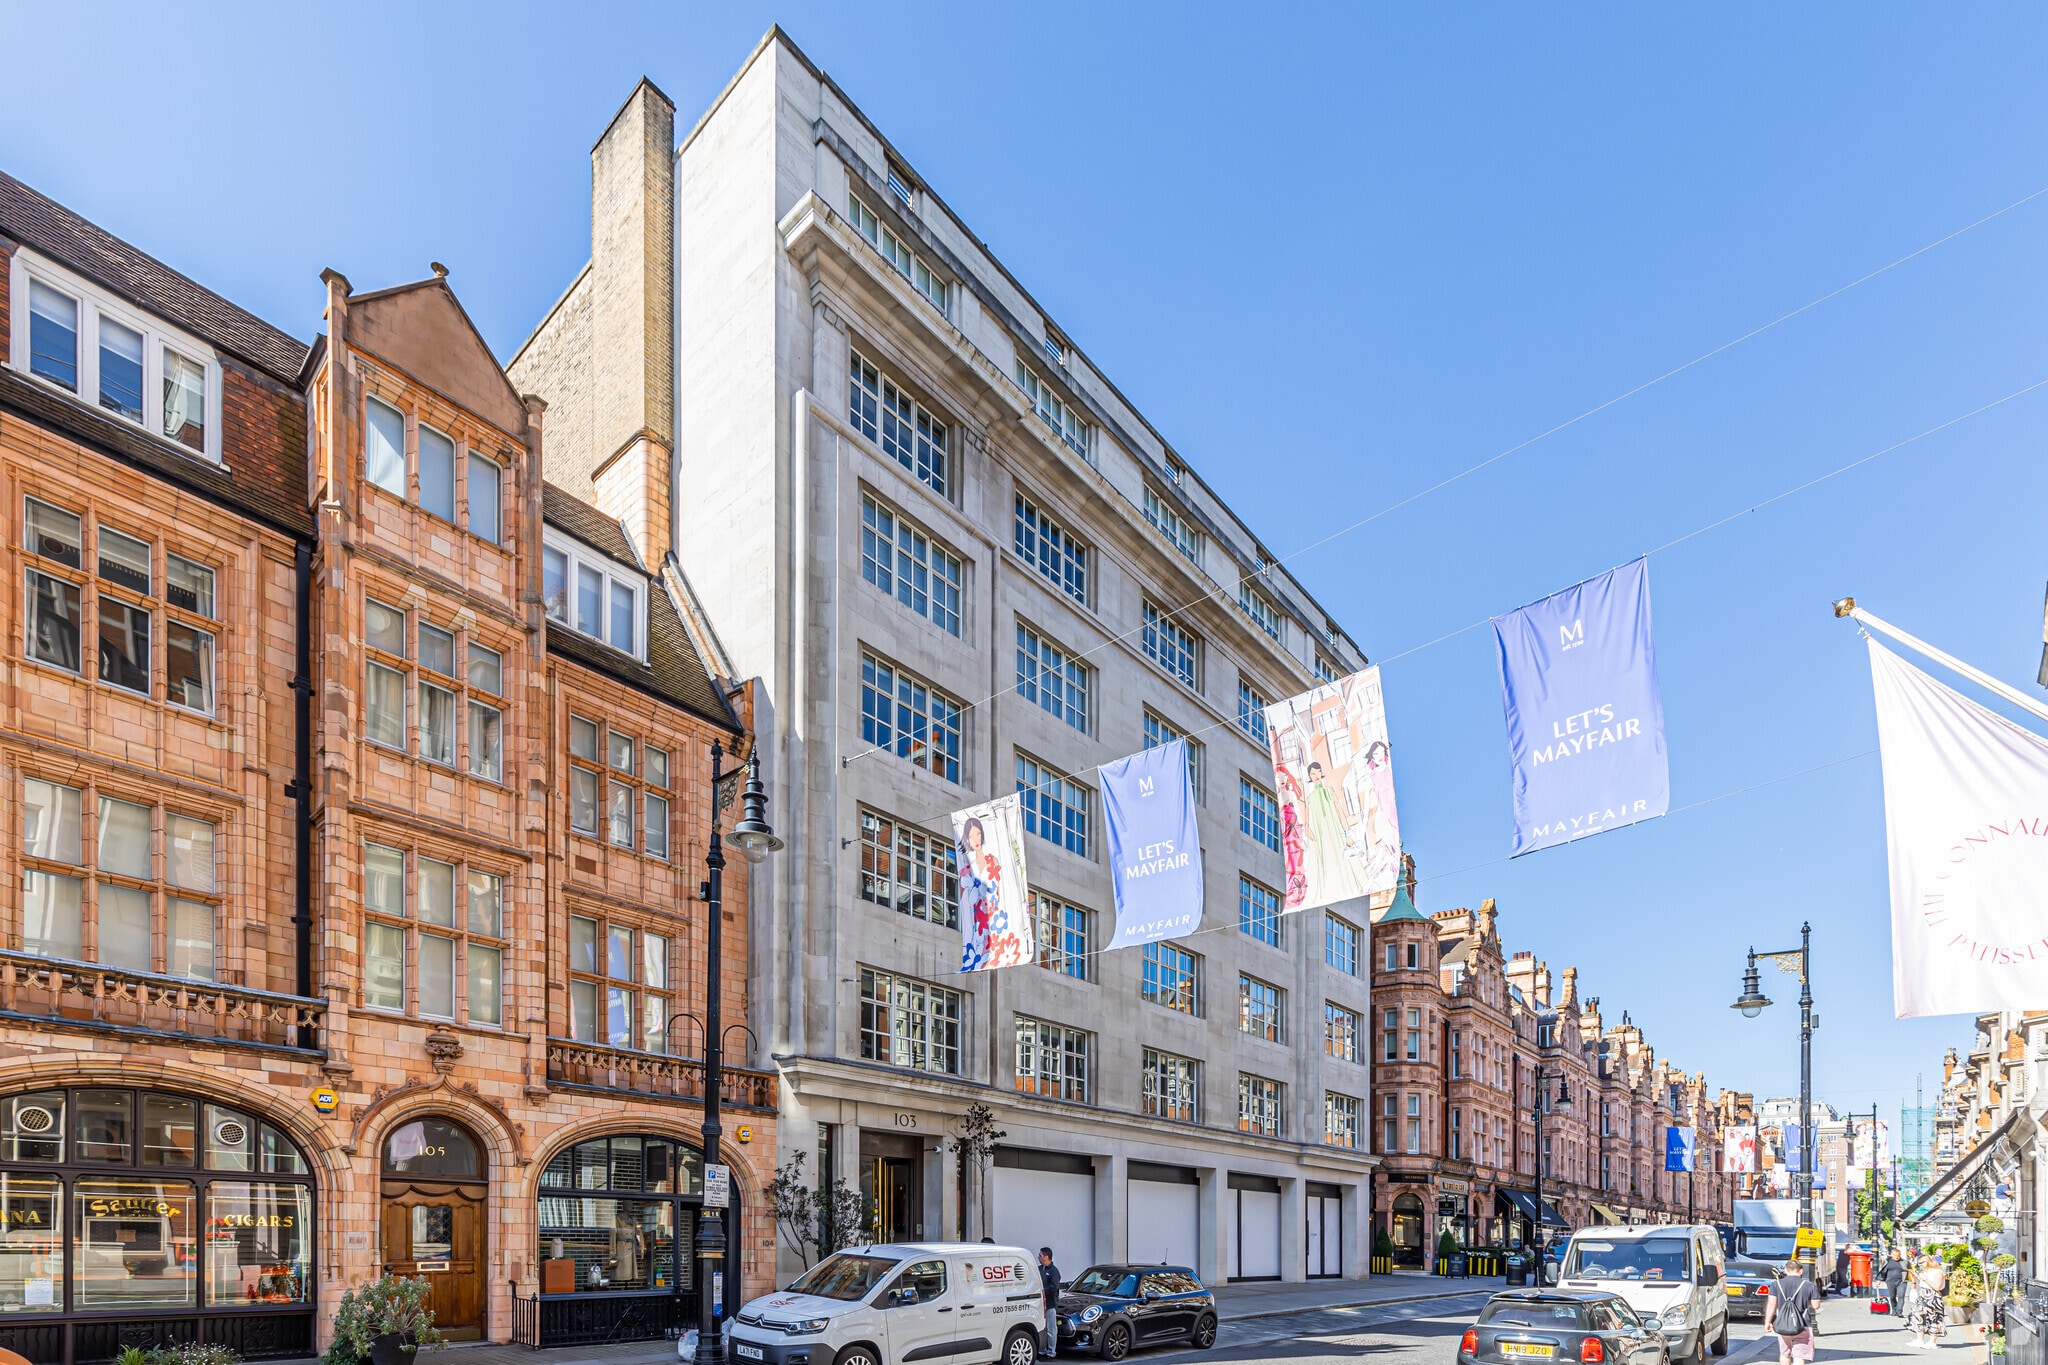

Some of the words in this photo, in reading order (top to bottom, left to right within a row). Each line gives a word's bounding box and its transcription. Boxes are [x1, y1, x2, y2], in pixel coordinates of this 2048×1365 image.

[1560, 618, 1584, 645] M
[1553, 703, 1615, 739] LET'S
[1532, 718, 1643, 767] MAYFAIR
[1139, 775, 1154, 793] M
[1532, 799, 1647, 839] MAYFAIR
[1138, 839, 1175, 861] LET'S
[1126, 852, 1190, 880] MAYFAIR
[1125, 914, 1190, 936] MAYFAIR
[1948, 934, 2048, 964] PATISSE
[319, 1095, 333, 1103] ADT
[894, 1112, 917, 1128] 103
[419, 1145, 445, 1156] 105
[223, 1214, 294, 1228] CIGARS
[661, 1254, 688, 1264] SAE
[982, 1265, 1012, 1280] GSF
[992, 1306, 1003, 1314] 020
